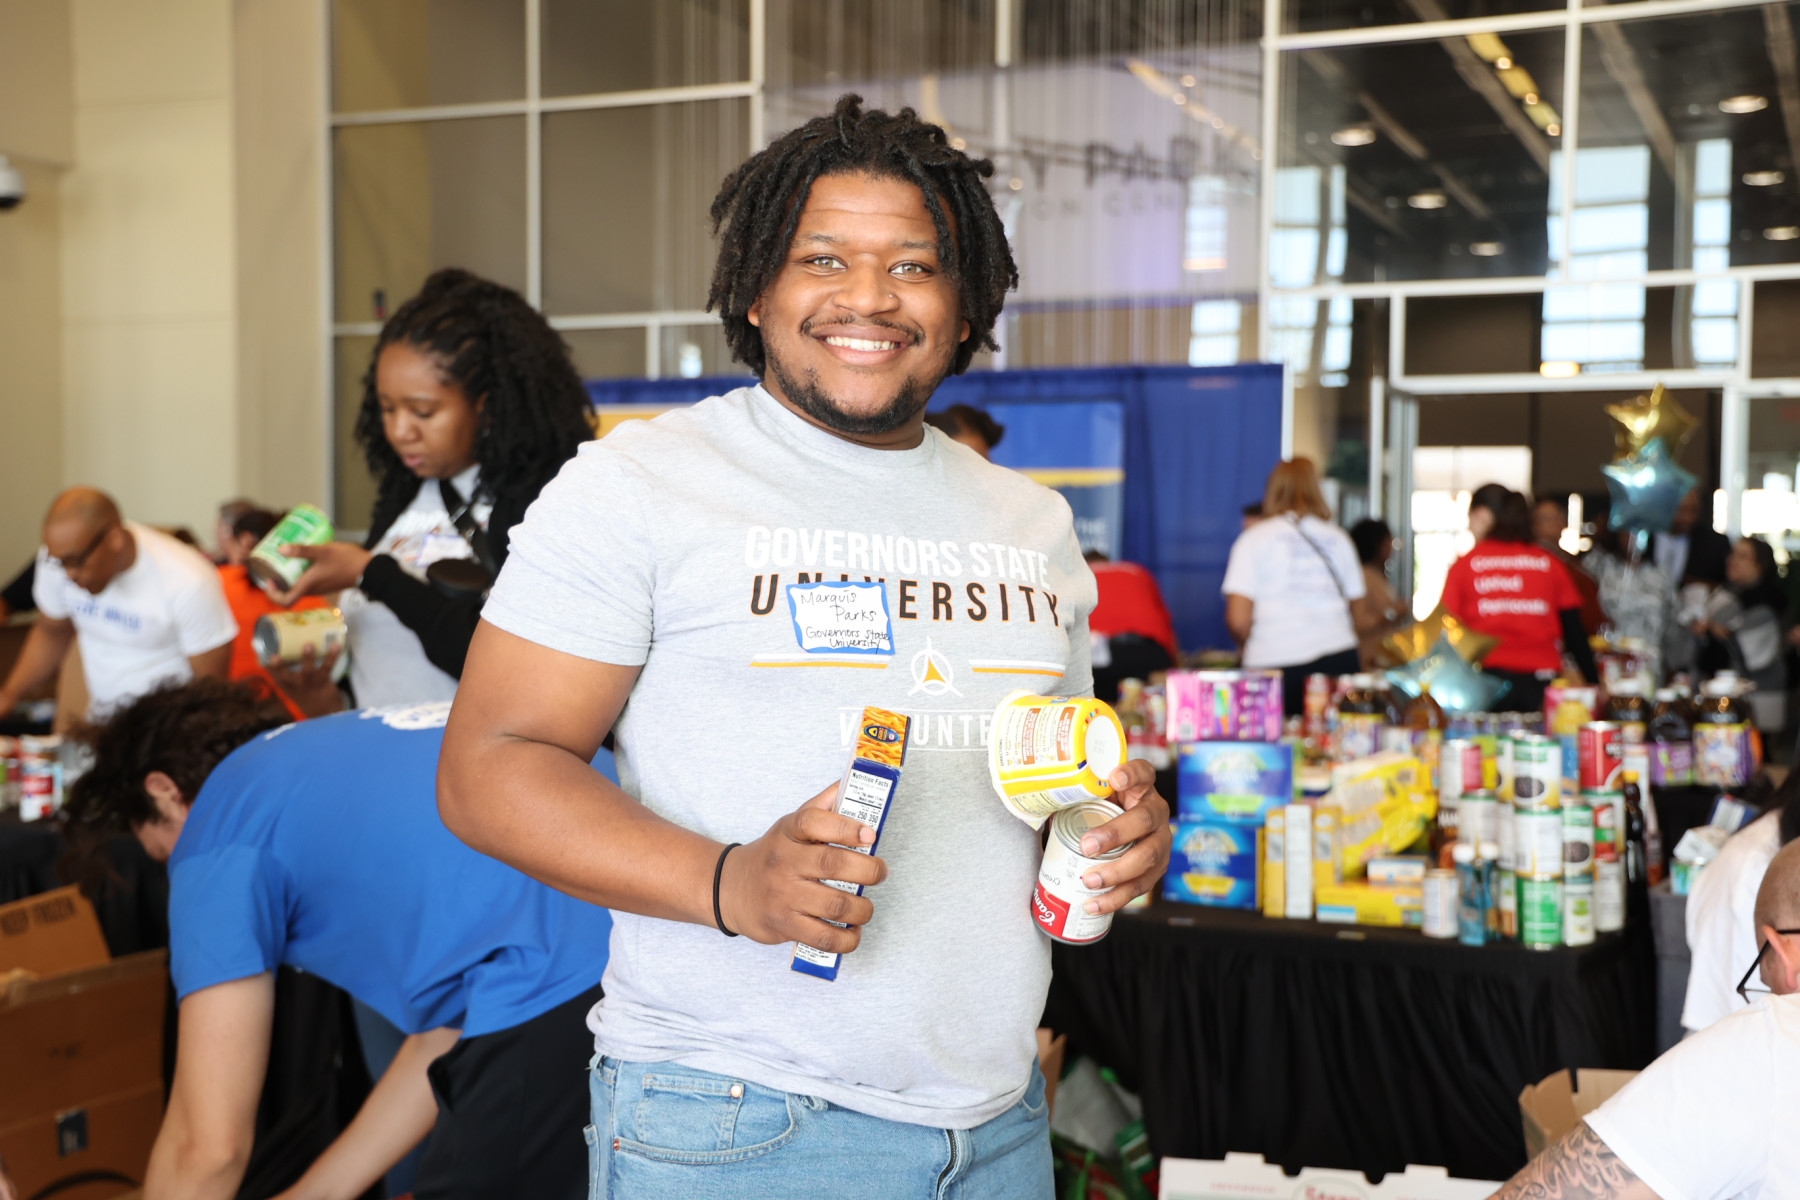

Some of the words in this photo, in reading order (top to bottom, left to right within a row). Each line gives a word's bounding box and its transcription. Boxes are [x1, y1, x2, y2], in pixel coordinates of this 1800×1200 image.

[745, 525, 963, 577] GOVERNORS
[967, 542, 1052, 590] STATE
[750, 572, 1060, 627] UERSITY
[800, 589, 857, 606] Marquis
[829, 604, 877, 623] Parks
[805, 626, 860, 639] Governors
[829, 638, 881, 654] University
[839, 713, 992, 747] VUNTE
[852, 772, 875, 784] Nutrition
[875, 778, 889, 788] Facts
[857, 810, 868, 821] 250
[868, 813, 879, 824] 350
